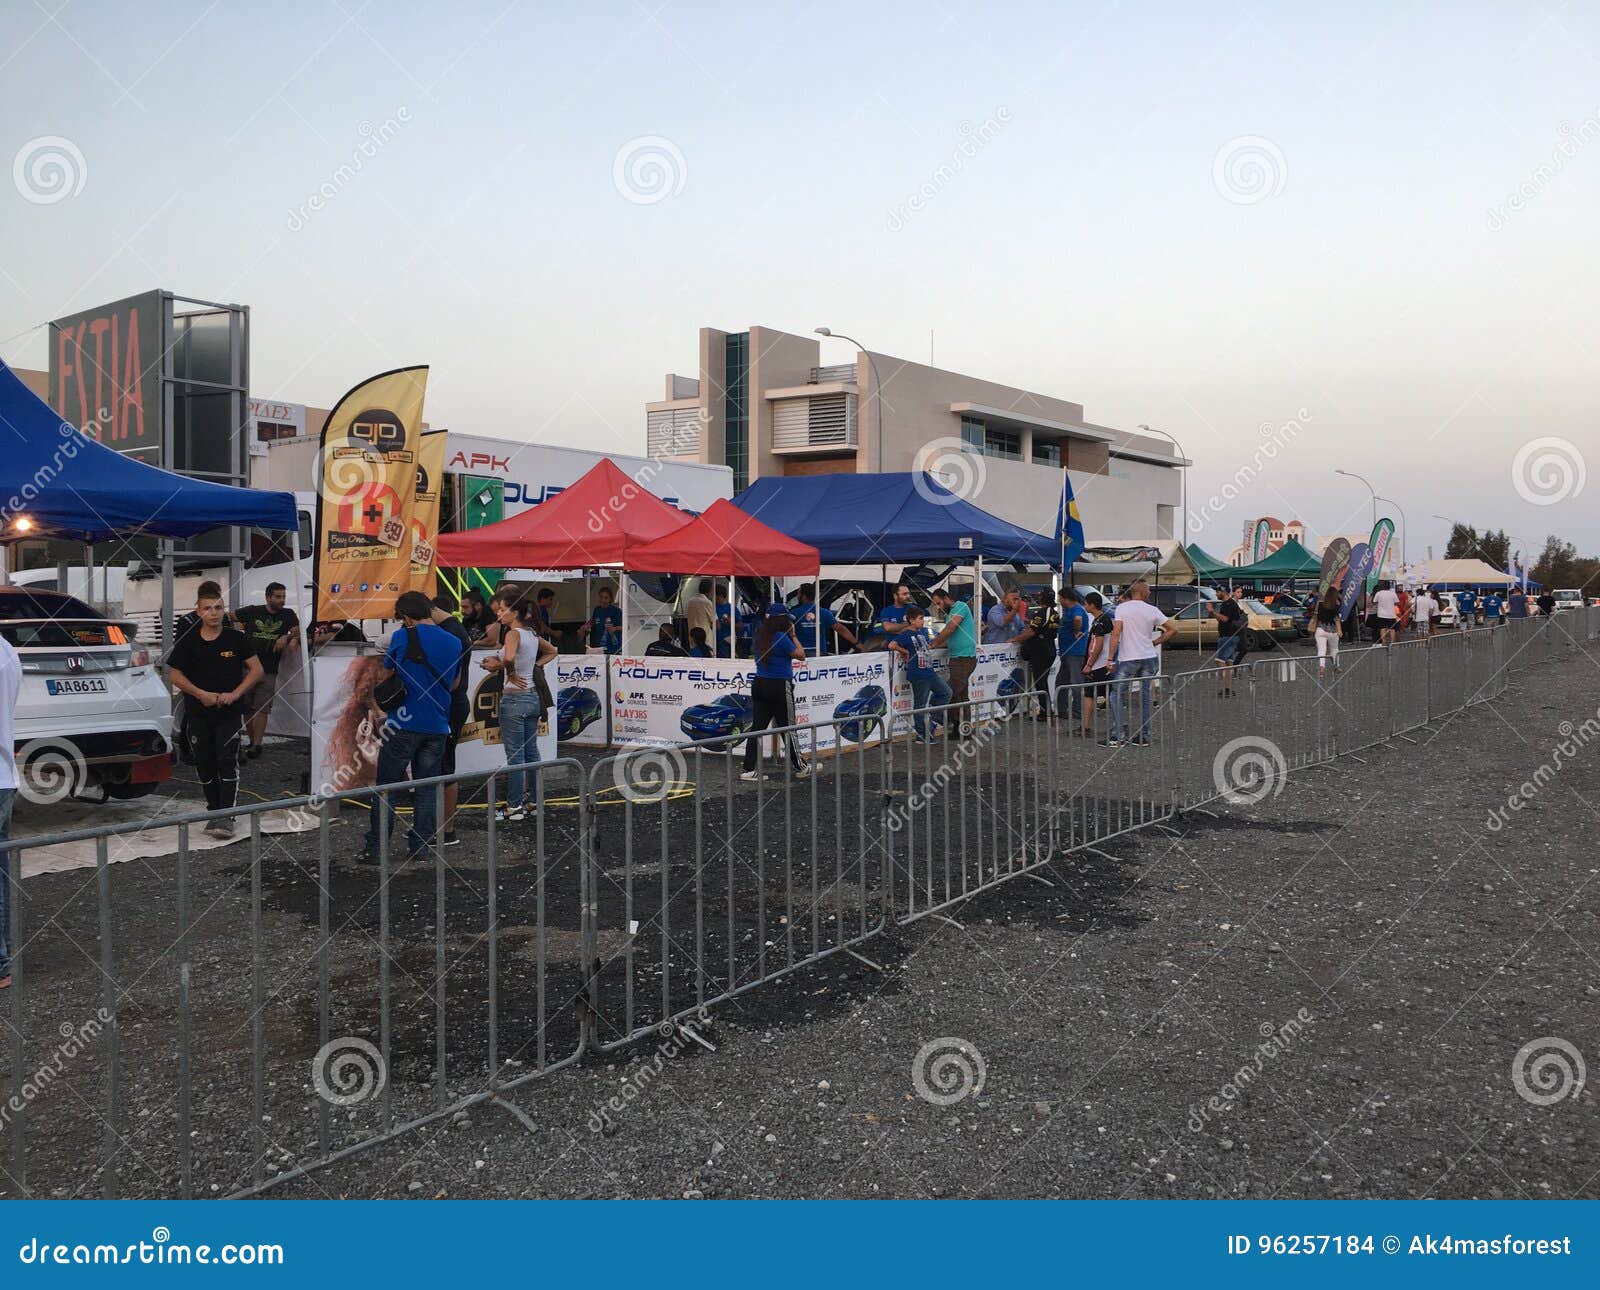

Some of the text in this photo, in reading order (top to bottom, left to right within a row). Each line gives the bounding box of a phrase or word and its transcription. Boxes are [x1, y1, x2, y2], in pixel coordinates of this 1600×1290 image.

[449, 451, 511, 472] APK
[612, 658, 646, 668] APK
[792, 661, 809, 670] PK
[56, 680, 106, 693] AA8611
[629, 692, 645, 700] APK
